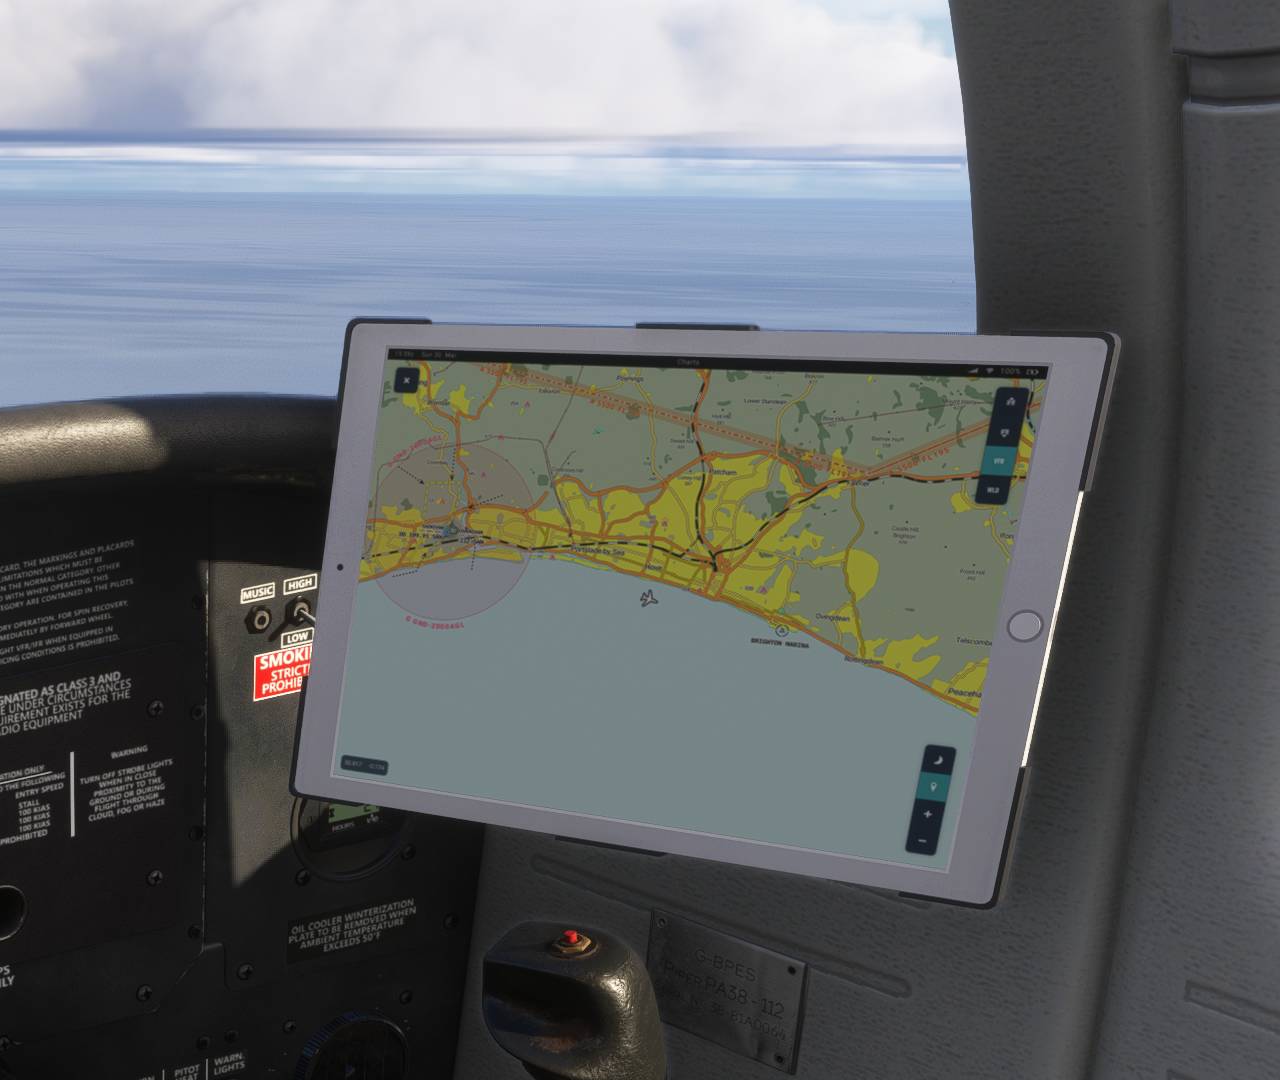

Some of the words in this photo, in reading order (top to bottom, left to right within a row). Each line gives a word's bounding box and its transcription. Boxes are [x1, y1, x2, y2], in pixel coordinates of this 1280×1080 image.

[288, 578, 312, 590] HIGH
[244, 586, 272, 600] MUSIC
[287, 631, 308, 643] LOW
[260, 648, 308, 670] SMOKI
[271, 664, 309, 681] STRICT
[41, 685, 55, 696] AS
[56, 679, 88, 693] CLASS
[89, 678, 95, 686] 3
[97, 671, 121, 684] AND
[262, 677, 302, 694] PROHIB
[23, 710, 83, 730] EQUIPMENT
[174, 1064, 200, 1077] PITOT
[214, 1061, 246, 1076] LIGHTS
